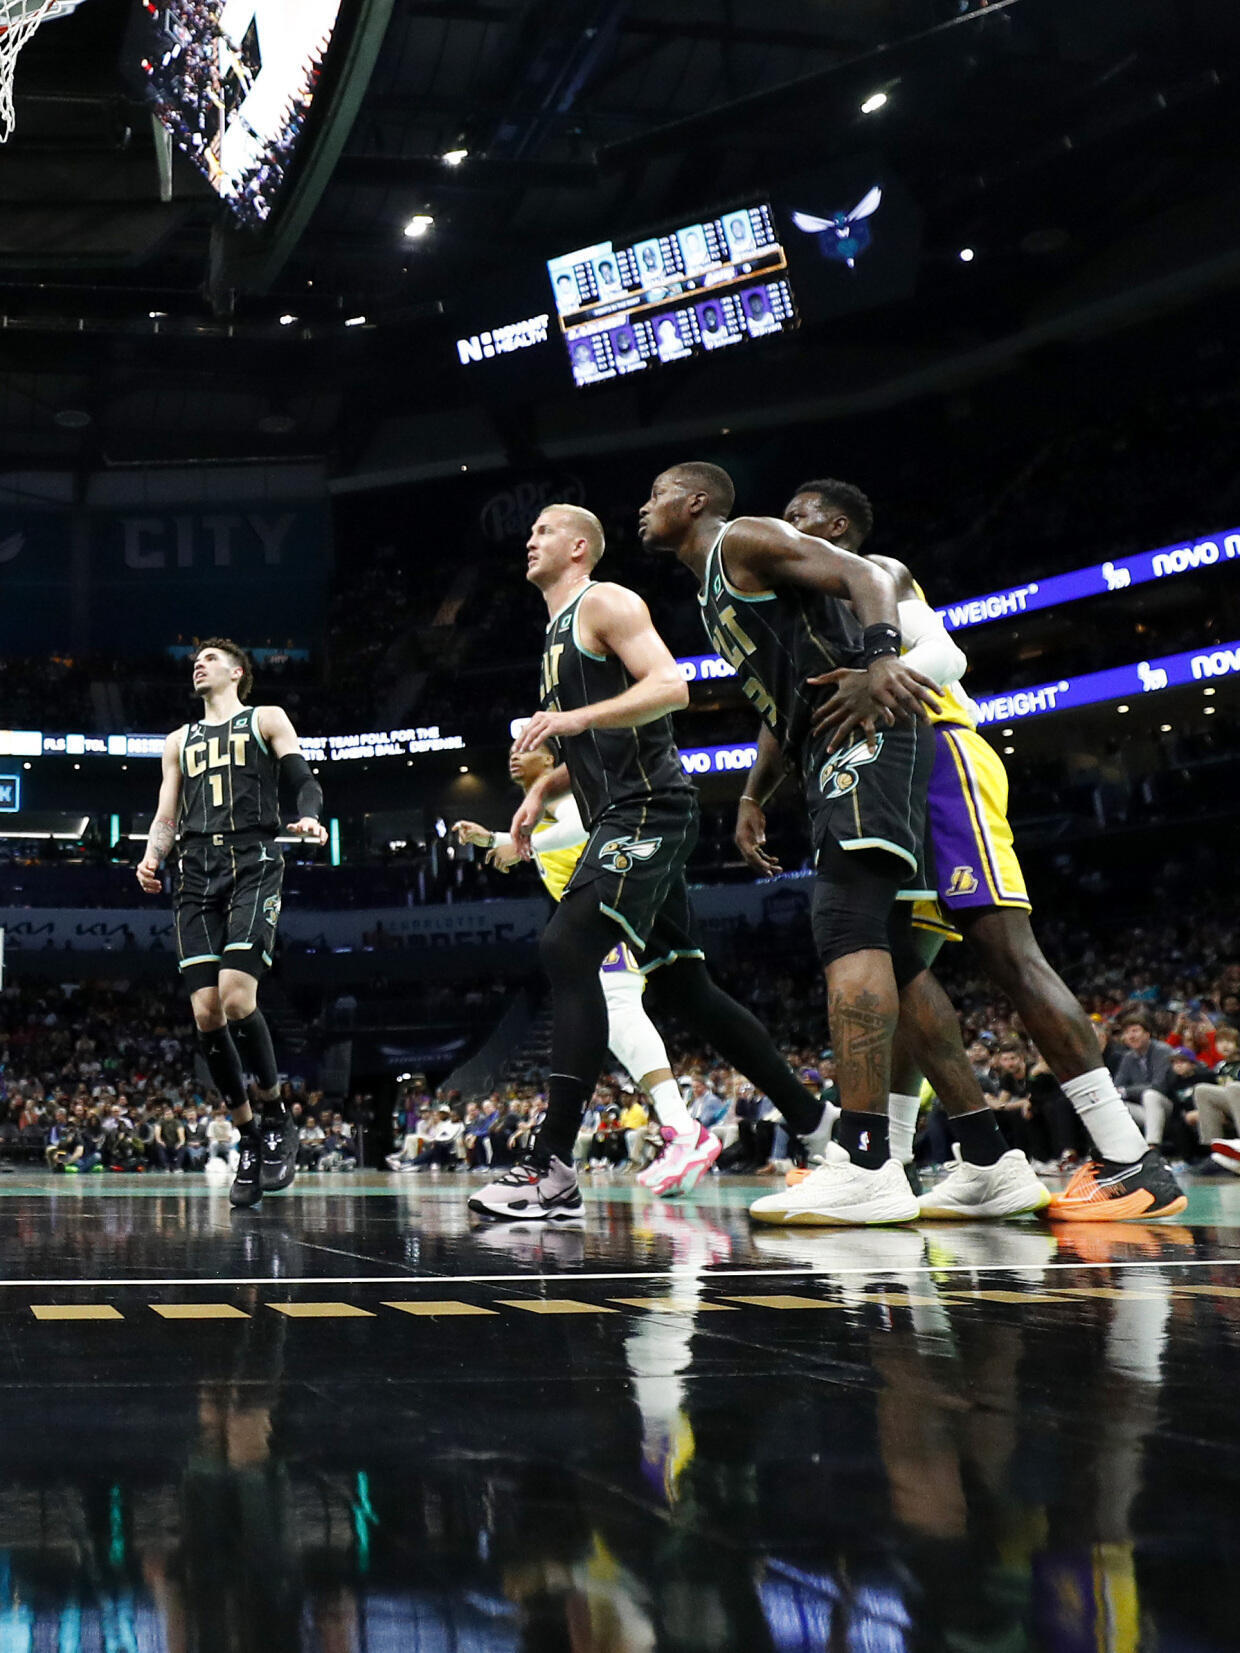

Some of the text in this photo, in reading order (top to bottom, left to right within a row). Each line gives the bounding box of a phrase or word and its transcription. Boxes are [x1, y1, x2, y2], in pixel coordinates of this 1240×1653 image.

[495, 327, 548, 355] HEALTH
[123, 513, 297, 568] CITY
[1151, 541, 1221, 578] novo
[948, 588, 1030, 628] WEIGHT
[540, 643, 565, 703] LT
[976, 685, 1059, 724] WEIGHT
[185, 733, 250, 778] CLT
[298, 726, 440, 749] FIRST TEAM FOUL FOR THE
[331, 745, 375, 761] LAKERS
[208, 773, 224, 807] 1
